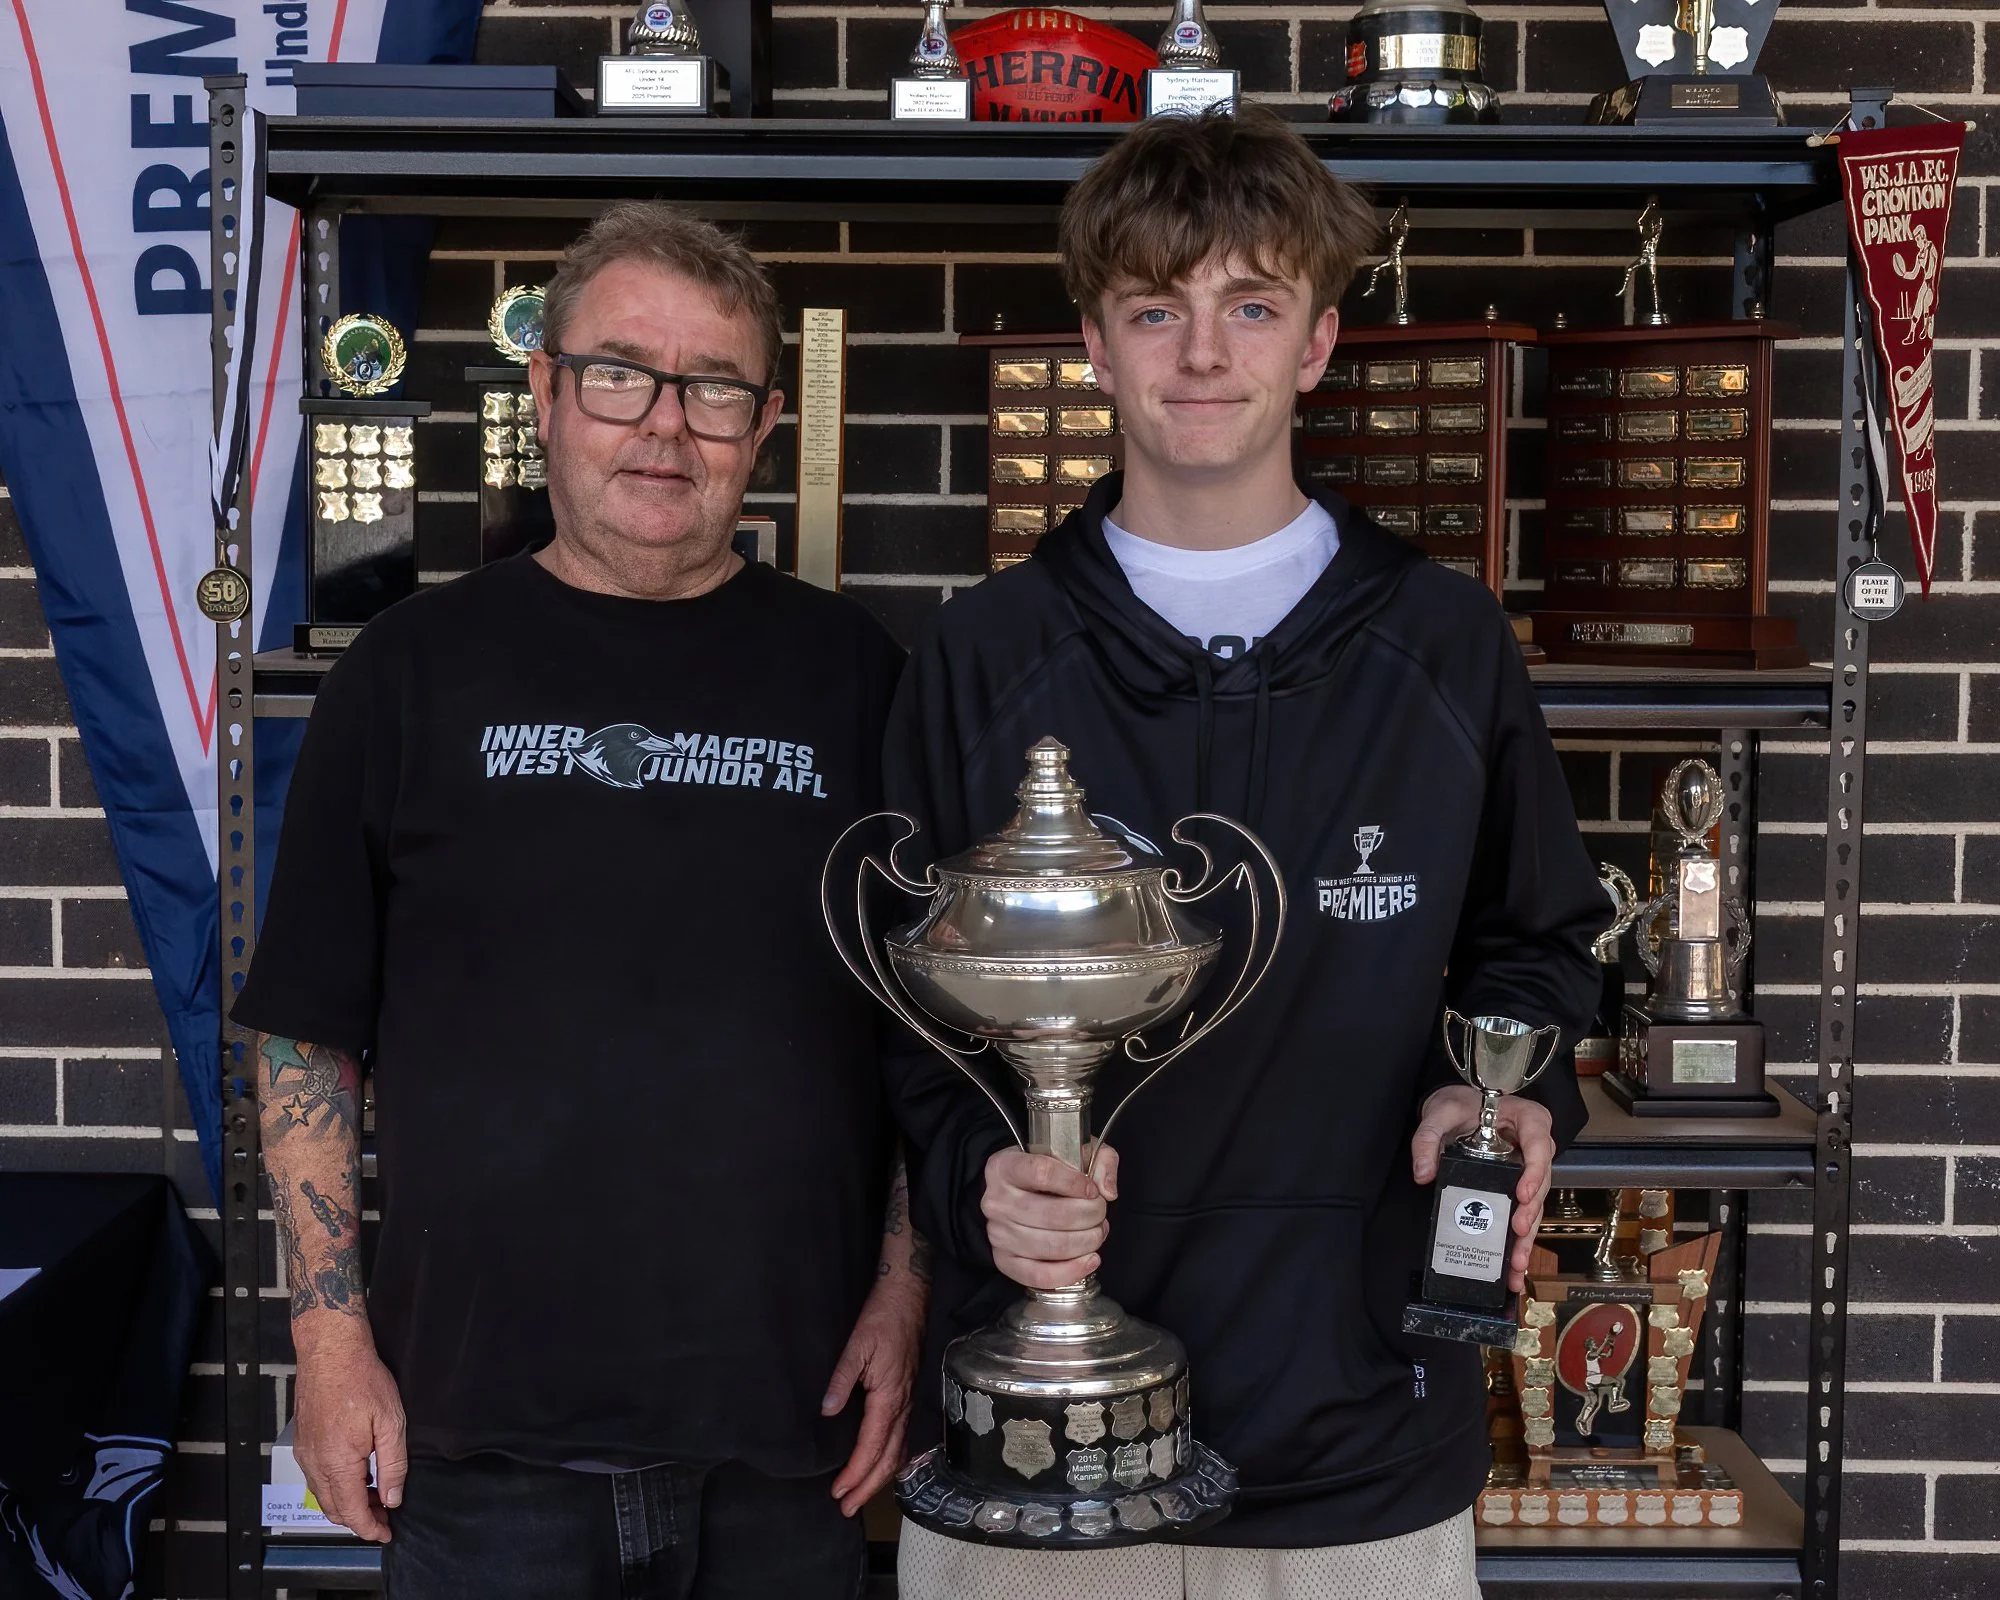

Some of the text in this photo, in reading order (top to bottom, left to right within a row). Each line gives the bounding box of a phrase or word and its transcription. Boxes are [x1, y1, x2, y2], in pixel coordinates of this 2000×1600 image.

[651, 10, 670, 19] AFL
[1861, 183, 1946, 217] CROYDON
[1863, 213, 1914, 246] PARK
[1861, 578, 1889, 586] PLAYER
[207, 580, 238, 602] 50
[1864, 597, 1885, 605] WEEK
[205, 603, 240, 613] GAMES
[480, 724, 585, 751] INNER
[672, 732, 815, 770] MAGPIES
[486, 750, 578, 778] WEST
[643, 756, 828, 799] JUNIOR AFL
[1318, 874, 1416, 887] INNER WEST MAGPIES JUNIOR AFL
[1318, 883, 1417, 921] PREMIERS
[1458, 1219, 1489, 1229] MAGPIES
[1436, 1241, 1502, 1257] Senior Club Champion
[1462, 1252, 1477, 1260] IWM
[1444, 1257, 1490, 1269] Ethan Lamrock
[1077, 1454, 1098, 1463] 2015
[1072, 1464, 1105, 1472] Matthew
[1114, 1466, 1149, 1478] Hennessy
[1073, 1473, 1103, 1481] Kannan
[267, 1502, 293, 1510] Coach
[266, 1513, 288, 1521] Greg
